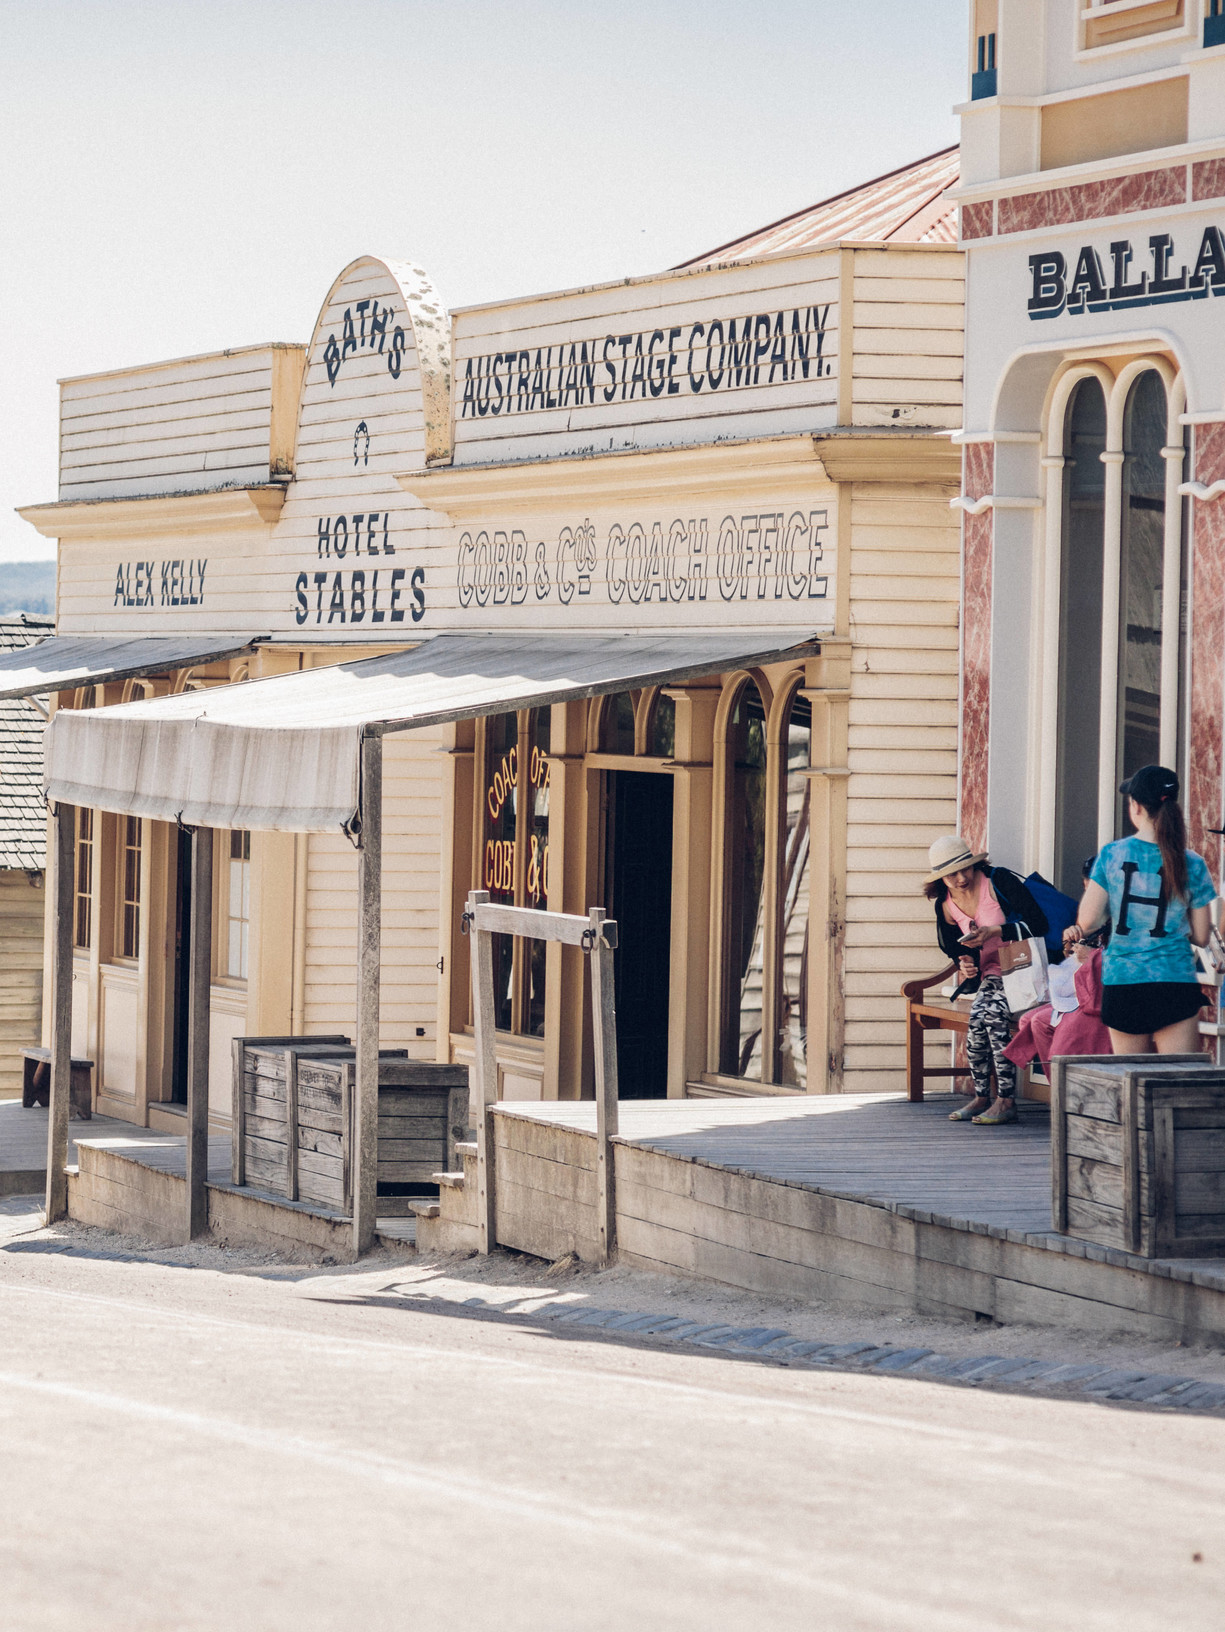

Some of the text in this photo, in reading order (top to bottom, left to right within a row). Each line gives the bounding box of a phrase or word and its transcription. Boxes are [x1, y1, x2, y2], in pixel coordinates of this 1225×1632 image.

[1028, 225, 1225, 320] BALLA
[323, 300, 406, 389] BATH'S
[462, 303, 831, 418] AUSTRALIAN STAGE COMPANY.
[317, 512, 396, 559] HOTEL
[457, 530, 528, 608] COBB
[534, 541, 551, 600] &
[606, 518, 708, 605] COACH
[716, 509, 828, 602] OFFICE
[114, 558, 208, 607] ALEX KELLY
[295, 566, 426, 625] STABLES
[487, 744, 519, 819] COAC
[1115, 861, 1169, 938] H
